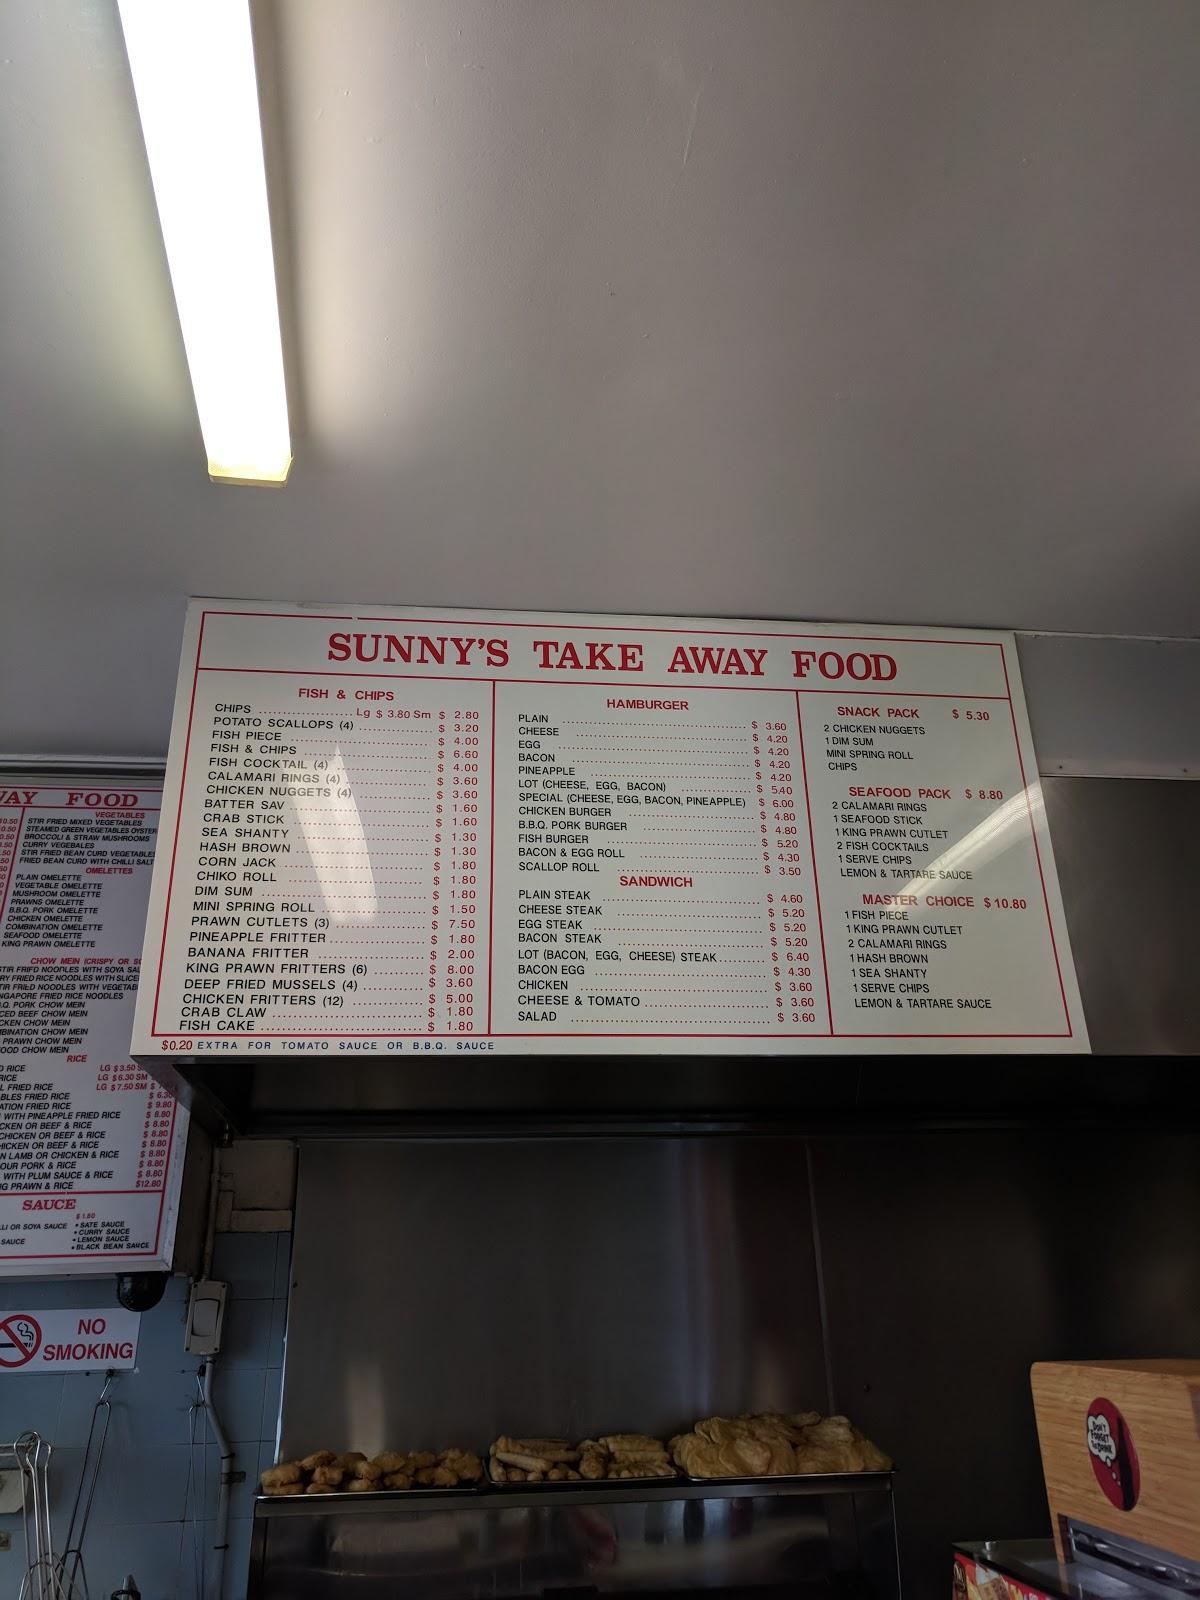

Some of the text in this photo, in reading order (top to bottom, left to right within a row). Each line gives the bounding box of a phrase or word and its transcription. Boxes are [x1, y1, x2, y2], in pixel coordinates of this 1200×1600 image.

[328, 633, 897, 680] SUNNY'S TAKE AWAY FOOD
[299, 688, 394, 701] FISH & CHIPS
[607, 699, 688, 710] HAMBURGER
[215, 704, 479, 720] CHIPS Lg $ 3.80 Sm $ 2.80
[838, 706, 989, 720] SNACK PACK $ 5.30
[214, 717, 478, 733] POTATO SCALLOPS (4) $ 3.20
[519, 714, 786, 730] PLAIN $ 3.60
[833, 724, 876, 733] CHICKEN
[879, 726, 925, 734] NUGGETS
[212, 730, 282, 740] FISH PIECE
[827, 750, 914, 759] MINI SPRING ROLL
[210, 758, 328, 770] FISH COCKTAIL (4)
[519, 779, 666, 792] LOT (CHEESE, EGG, BACON)
[849, 787, 1003, 800] SEAFOOD PACK $ 8.80
[66, 792, 138, 807] FOOD
[205, 799, 284, 810] BATTER SAV
[519, 793, 563, 802] SPECIAL
[567, 794, 613, 804] (CHEESE,
[617, 795, 641, 805] EGG,
[645, 796, 683, 806] BACON,
[687, 797, 745, 808] PINEAPPLE)
[759, 798, 765, 806] $
[841, 814, 890, 824] SEAFOOD
[894, 816, 922, 824] STICK
[519, 820, 627, 830] B.B.Q. PORK BURGER
[202, 828, 288, 838] SEA SHANTY
[199, 857, 276, 867] CORN JACK
[519, 862, 599, 872] SCALLOP ROLL
[620, 876, 692, 887] SANDWICH
[863, 894, 1026, 909] MASTER CHOICE $ 10.80
[192, 916, 475, 930] PRAWN CUTLETS (3) $ 7.50
[846, 924, 962, 934] 1 KING PRAWN CUTLET
[190, 932, 325, 942] PINEAPPLE FRITTER
[519, 949, 717, 962] LOT (BACON, EGG, CHEESE) STEAK
[185, 979, 357, 992] DEEP FRIED MUSSELS (4)
[853, 983, 929, 993] 1 SERVE CHIPS
[183, 994, 343, 1008] CHICKEN FRITTERS (12)
[518, 995, 640, 1006] CHEESE & TOMATO
[855, 998, 992, 1008] LEMON & TARTARE SAUCE
[518, 1011, 556, 1021] SALAD
[180, 1020, 254, 1030] FISH CAKE
[162, 1040, 192, 1051] $0.20
[22, 1199, 76, 1210] SAUCE
[78, 1319, 106, 1334] NO
[43, 1343, 133, 1360] SMOKING
